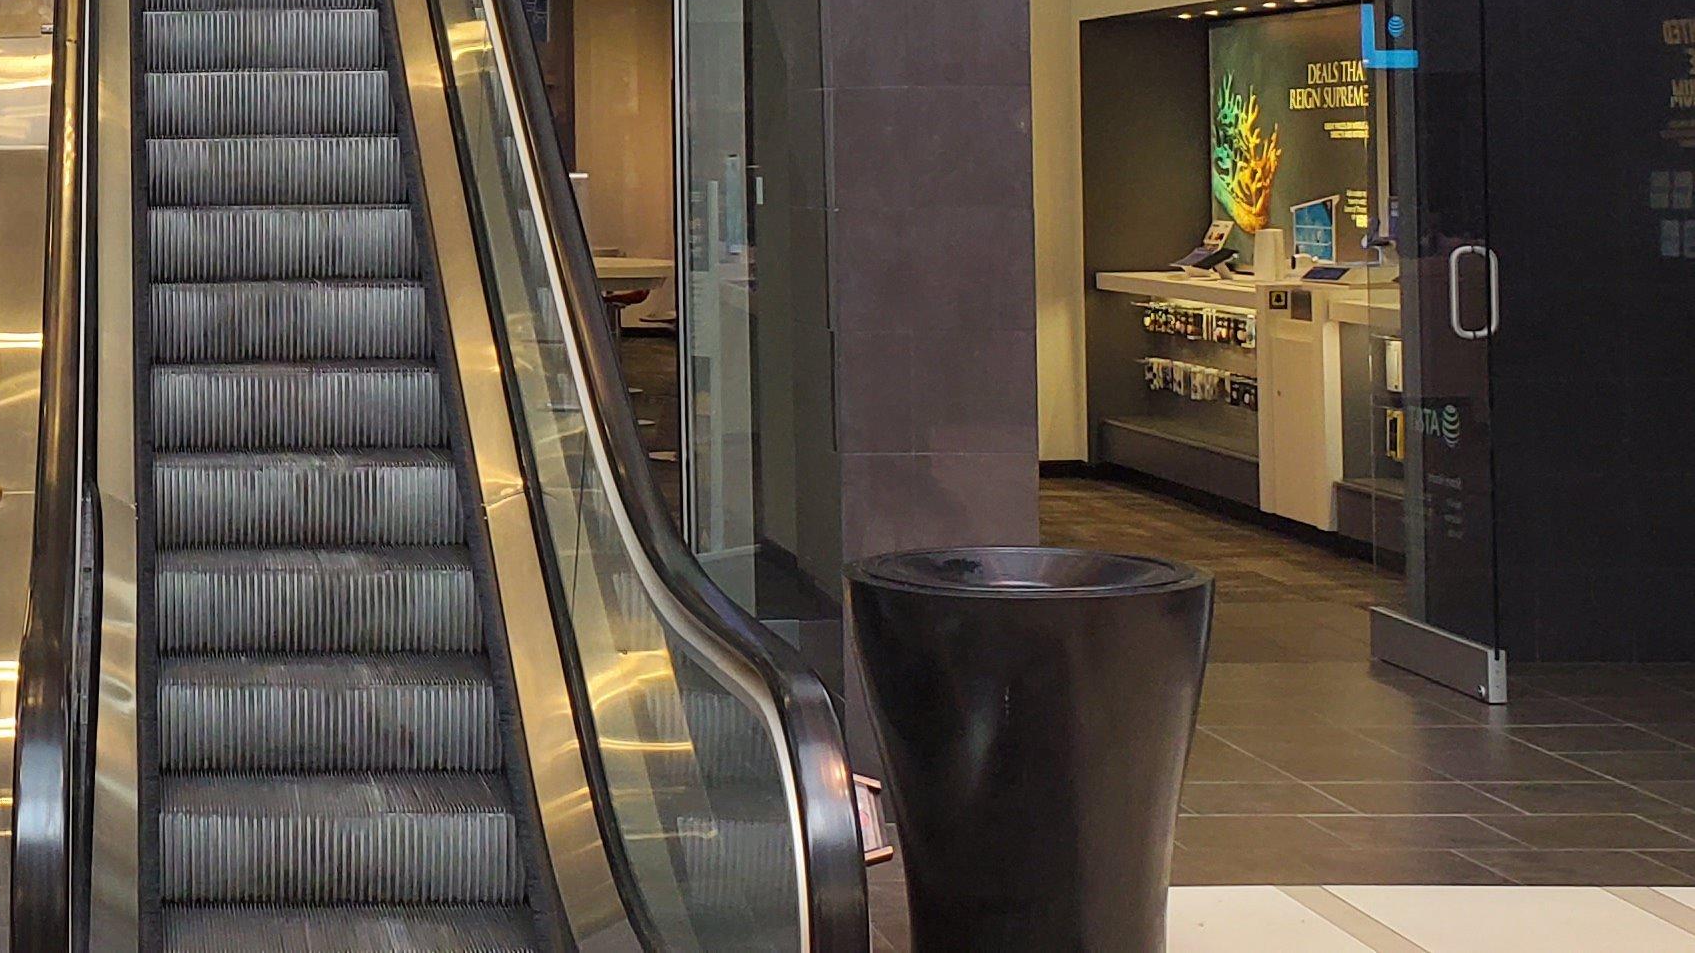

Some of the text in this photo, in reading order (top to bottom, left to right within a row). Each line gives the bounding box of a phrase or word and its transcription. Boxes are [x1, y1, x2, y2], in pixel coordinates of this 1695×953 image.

[1307, 60, 1365, 84] DEALS THA
[1289, 85, 1369, 110] REIGN SUPREME
